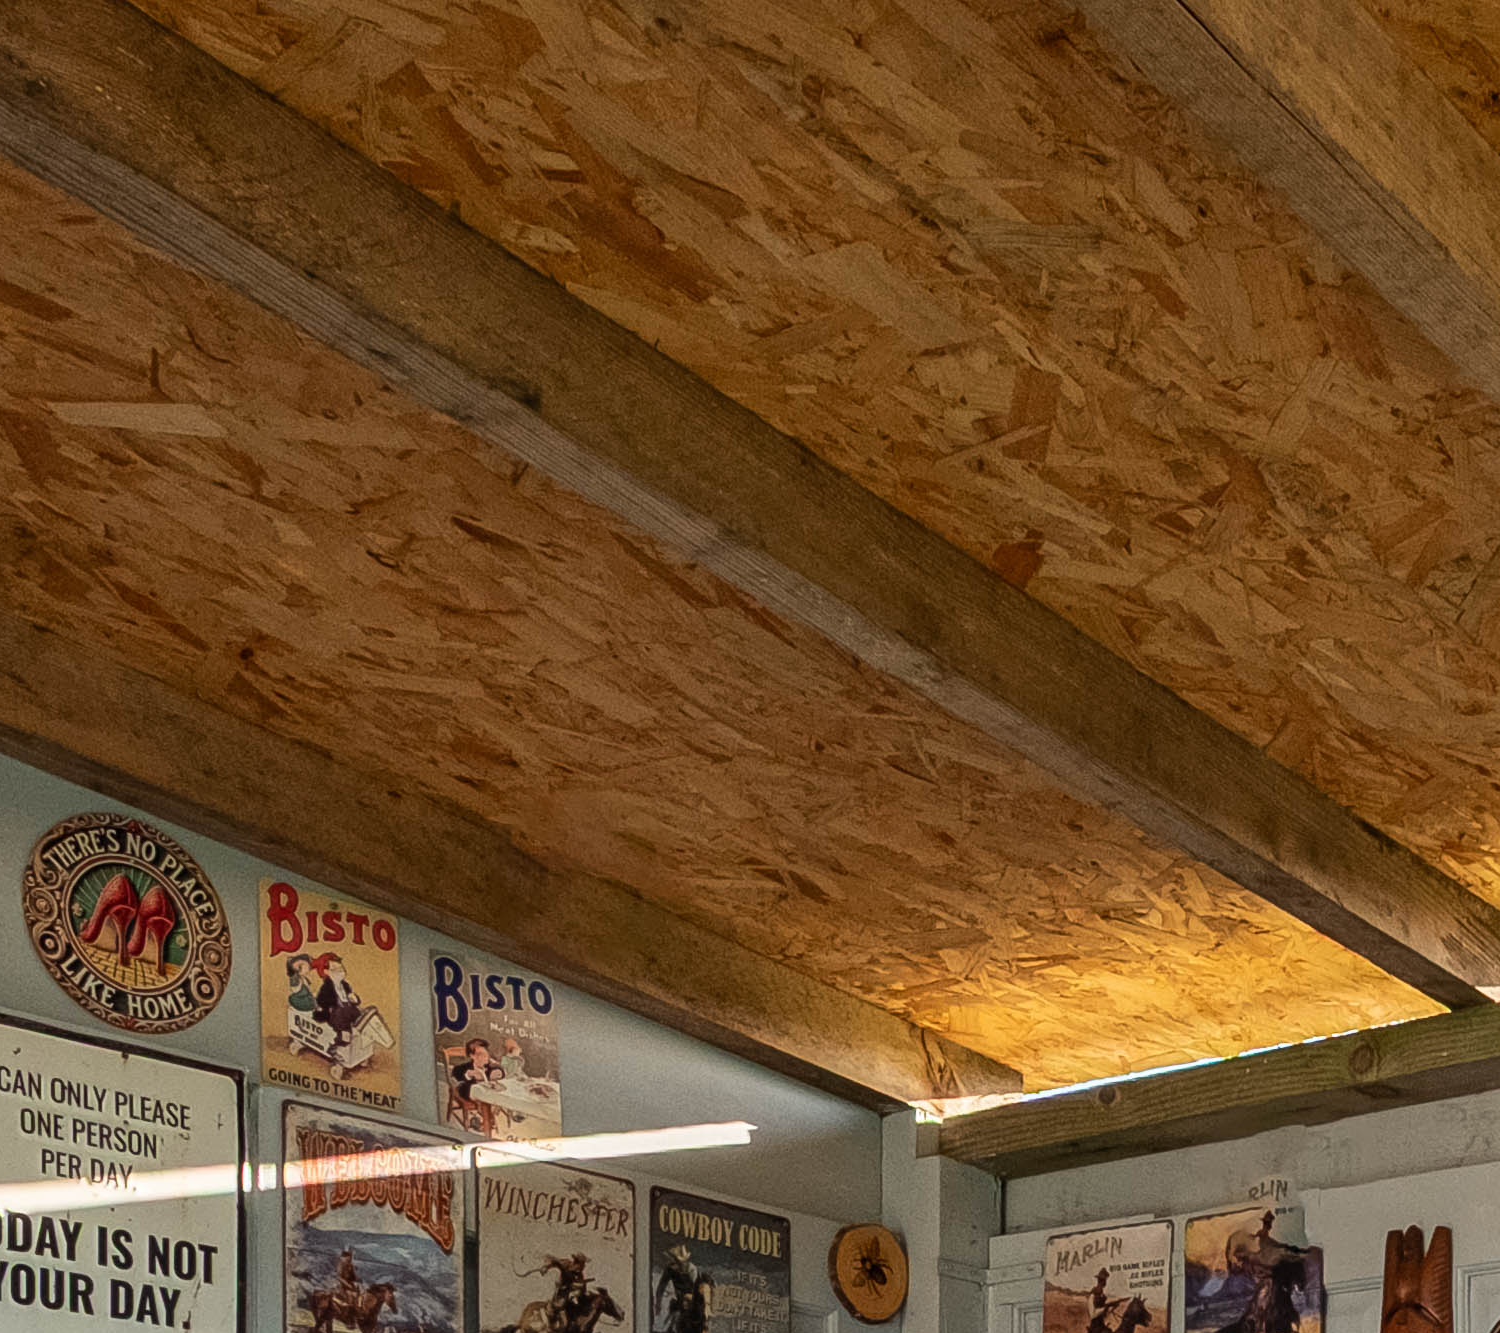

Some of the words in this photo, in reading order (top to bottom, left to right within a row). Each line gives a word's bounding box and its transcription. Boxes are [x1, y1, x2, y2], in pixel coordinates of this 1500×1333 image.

[43, 828, 120, 870] THERE'S
[126, 832, 156, 861] NO
[160, 854, 214, 917] PLACE
[267, 882, 396, 957] BISTO
[61, 956, 116, 1008] LIKE
[128, 988, 193, 1018] HOME
[433, 957, 553, 1033] BISTO
[50, 1077, 107, 1112] ONLY
[114, 1092, 191, 1131] PLEASE
[20, 1109, 64, 1140] ONE
[72, 1121, 156, 1158] PERSON
[484, 1176, 629, 1237] WINCHESTER
[660, 1205, 734, 1247] COWBOY
[740, 1224, 781, 1258] CODE
[97, 1226, 133, 1270] IS
[148, 1234, 218, 1284] NOT
[1055, 1237, 1122, 1276] MARLIN
[109, 1279, 190, 1329] DAY.
